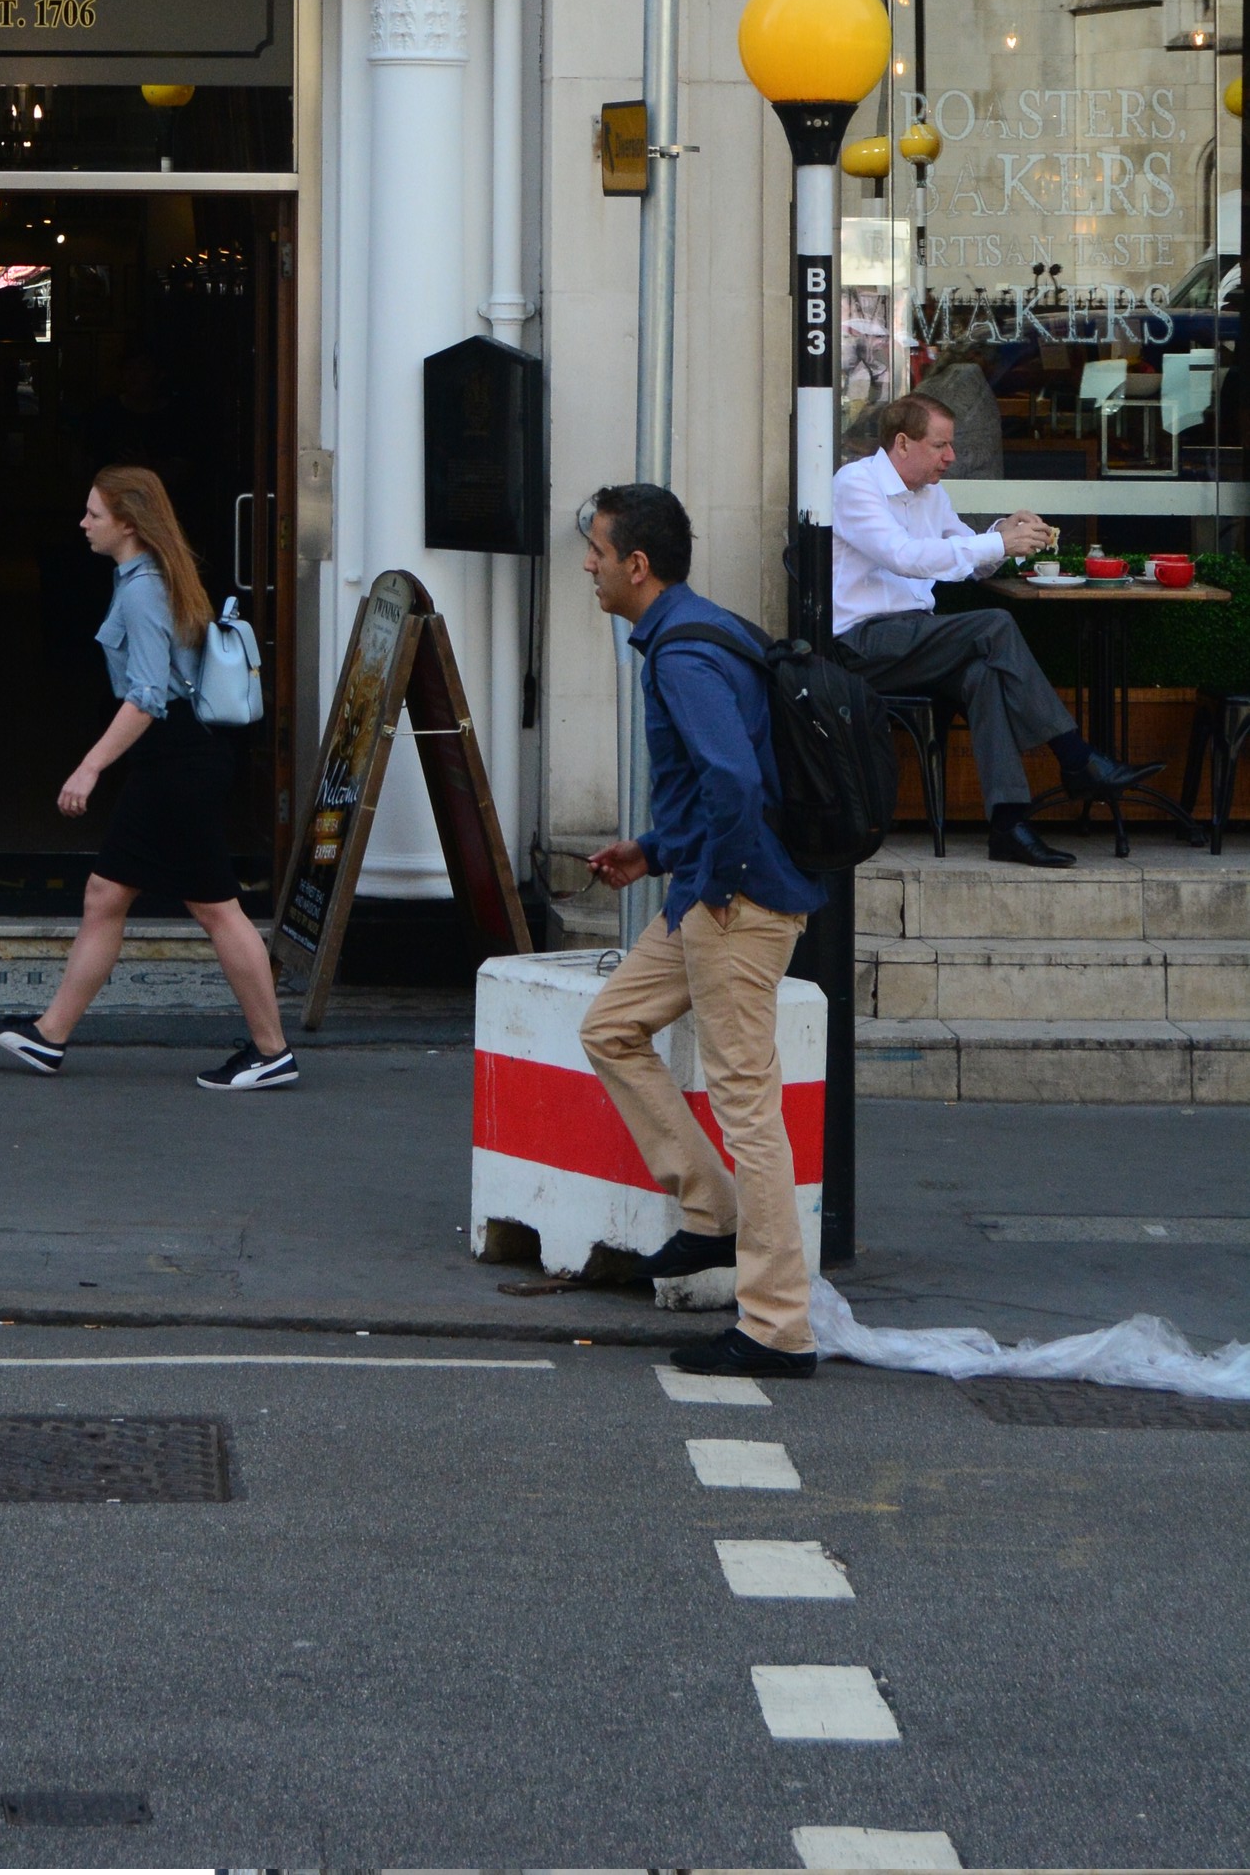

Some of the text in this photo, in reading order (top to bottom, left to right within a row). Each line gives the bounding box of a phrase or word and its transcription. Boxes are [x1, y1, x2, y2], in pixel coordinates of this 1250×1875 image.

[900, 88, 1187, 143] ROASTERS,
[1068, 234, 1175, 267] TASTE
[906, 283, 1175, 345] MAKERS
